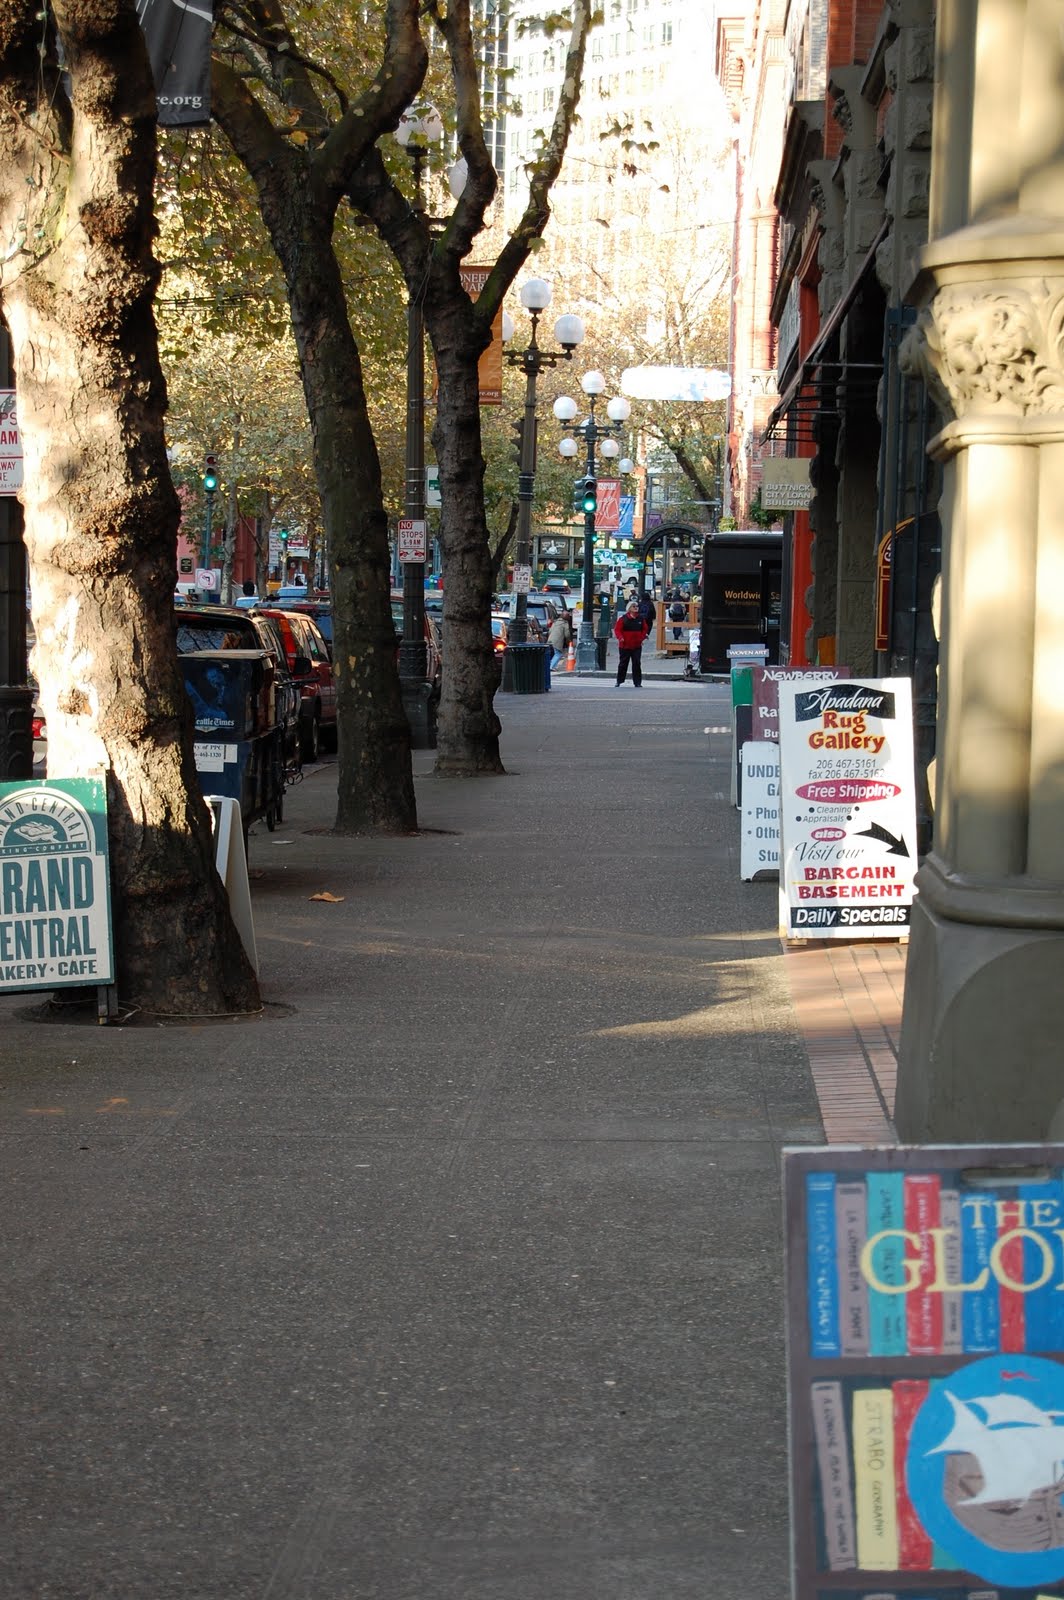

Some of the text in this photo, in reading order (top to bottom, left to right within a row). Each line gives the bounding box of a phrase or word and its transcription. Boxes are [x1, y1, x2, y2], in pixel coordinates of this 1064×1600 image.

[765, 484, 811, 492] BUTTNICK
[765, 491, 811, 499] CITY LOAN
[400, 521, 412, 529] NO
[401, 531, 424, 539] STOPS
[761, 669, 839, 682] NEWBERRY
[803, 687, 884, 716] Apadana
[758, 706, 780, 719] Ra
[213, 717, 235, 727] Times
[823, 709, 868, 735] Rug
[763, 729, 780, 738] Bu
[808, 731, 886, 754] Gallery
[816, 759, 876, 769] 206 467-5161
[808, 769, 823, 779] fax
[825, 769, 841, 779] 206
[807, 784, 895, 799] Free Shipping
[816, 806, 852, 815] Cleaning
[32, 797, 84, 839] CENTRAL
[803, 815, 844, 824] Appraisals
[814, 829, 843, 839] also
[35, 843, 84, 852] COMPANY
[795, 841, 864, 862] Visit our
[804, 866, 896, 881] BARGAIN
[798, 884, 905, 899] BASEMENT
[796, 906, 907, 926] Daily Specials
[58, 960, 98, 976] CAFE
[962, 1200, 1061, 1229] THE
[864, 1400, 886, 1539] STRABO GEOGRAPHY
